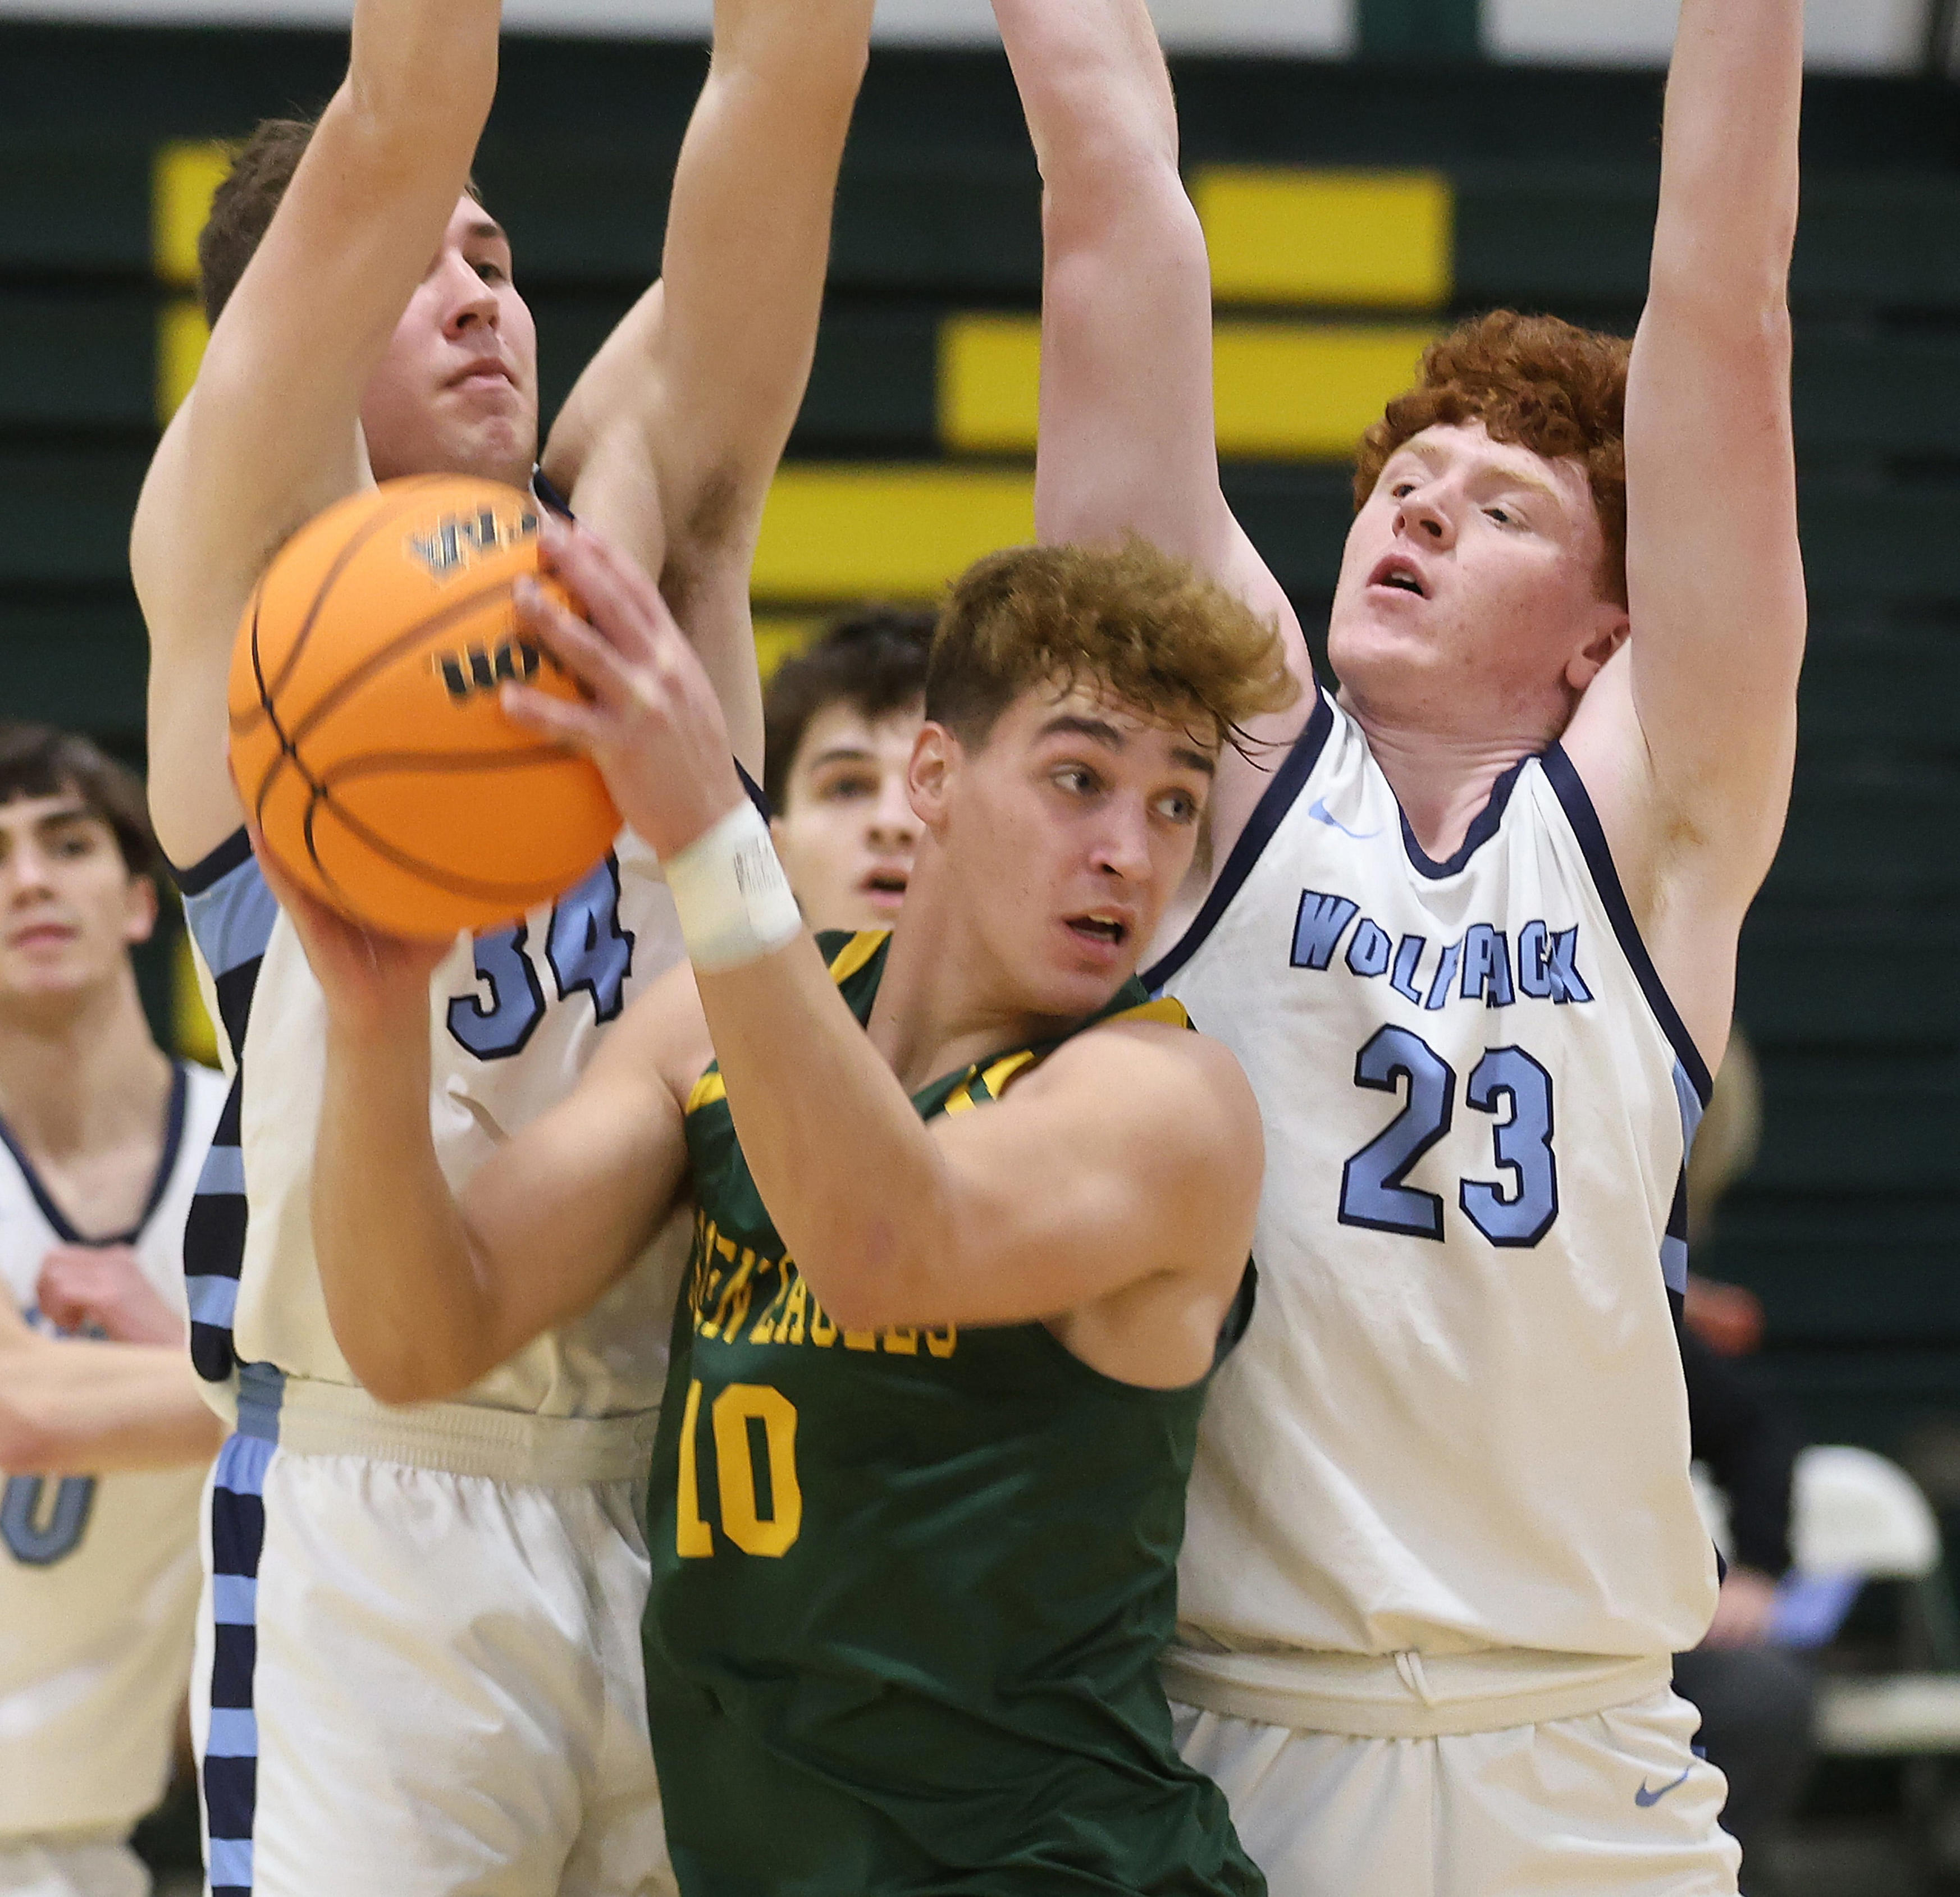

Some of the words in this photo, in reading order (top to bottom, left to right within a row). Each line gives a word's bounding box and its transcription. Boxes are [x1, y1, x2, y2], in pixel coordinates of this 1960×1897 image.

[447, 849, 635, 1061] 34
[1337, 1023, 1559, 1249] 23
[676, 1378, 803, 1558] 10
